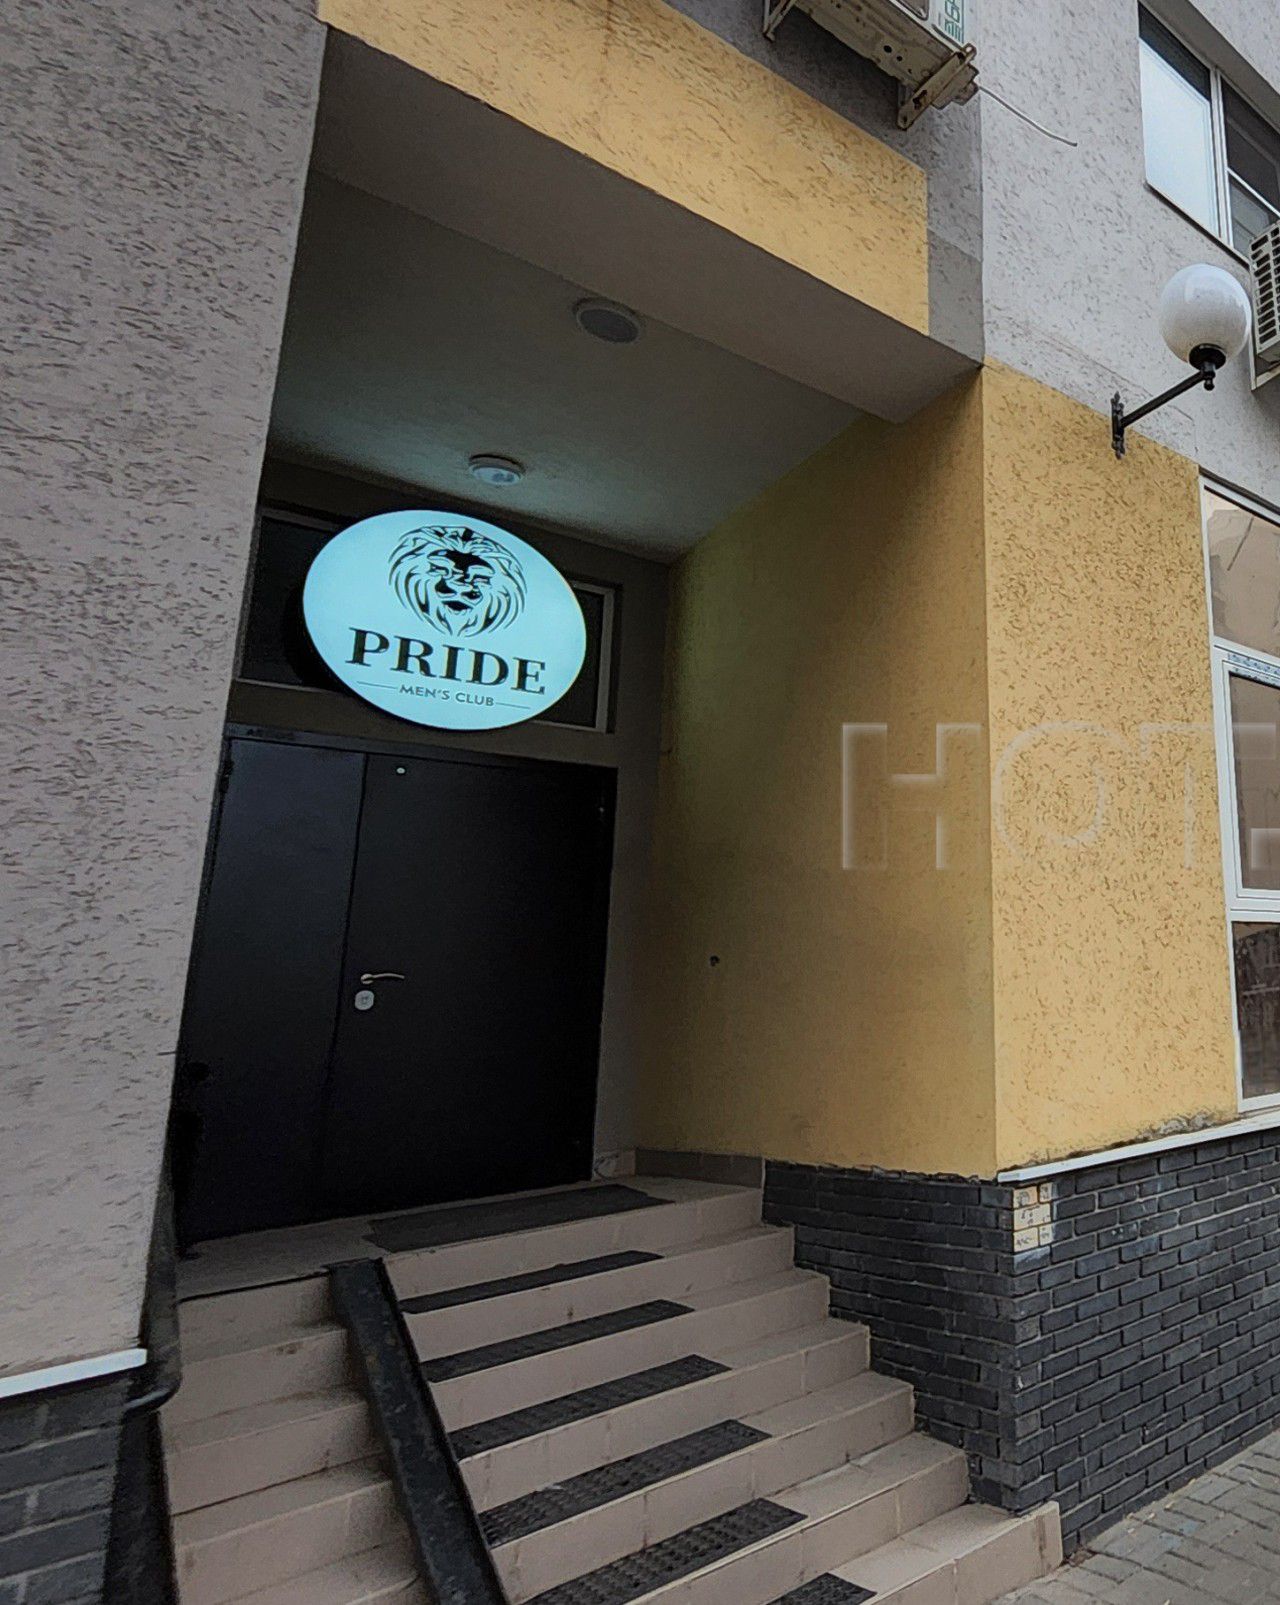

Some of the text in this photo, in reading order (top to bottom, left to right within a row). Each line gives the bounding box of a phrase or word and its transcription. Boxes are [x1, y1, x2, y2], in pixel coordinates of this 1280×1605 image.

[346, 627, 546, 695] PRIDE
[400, 684, 494, 707] MEN'S CLUB
